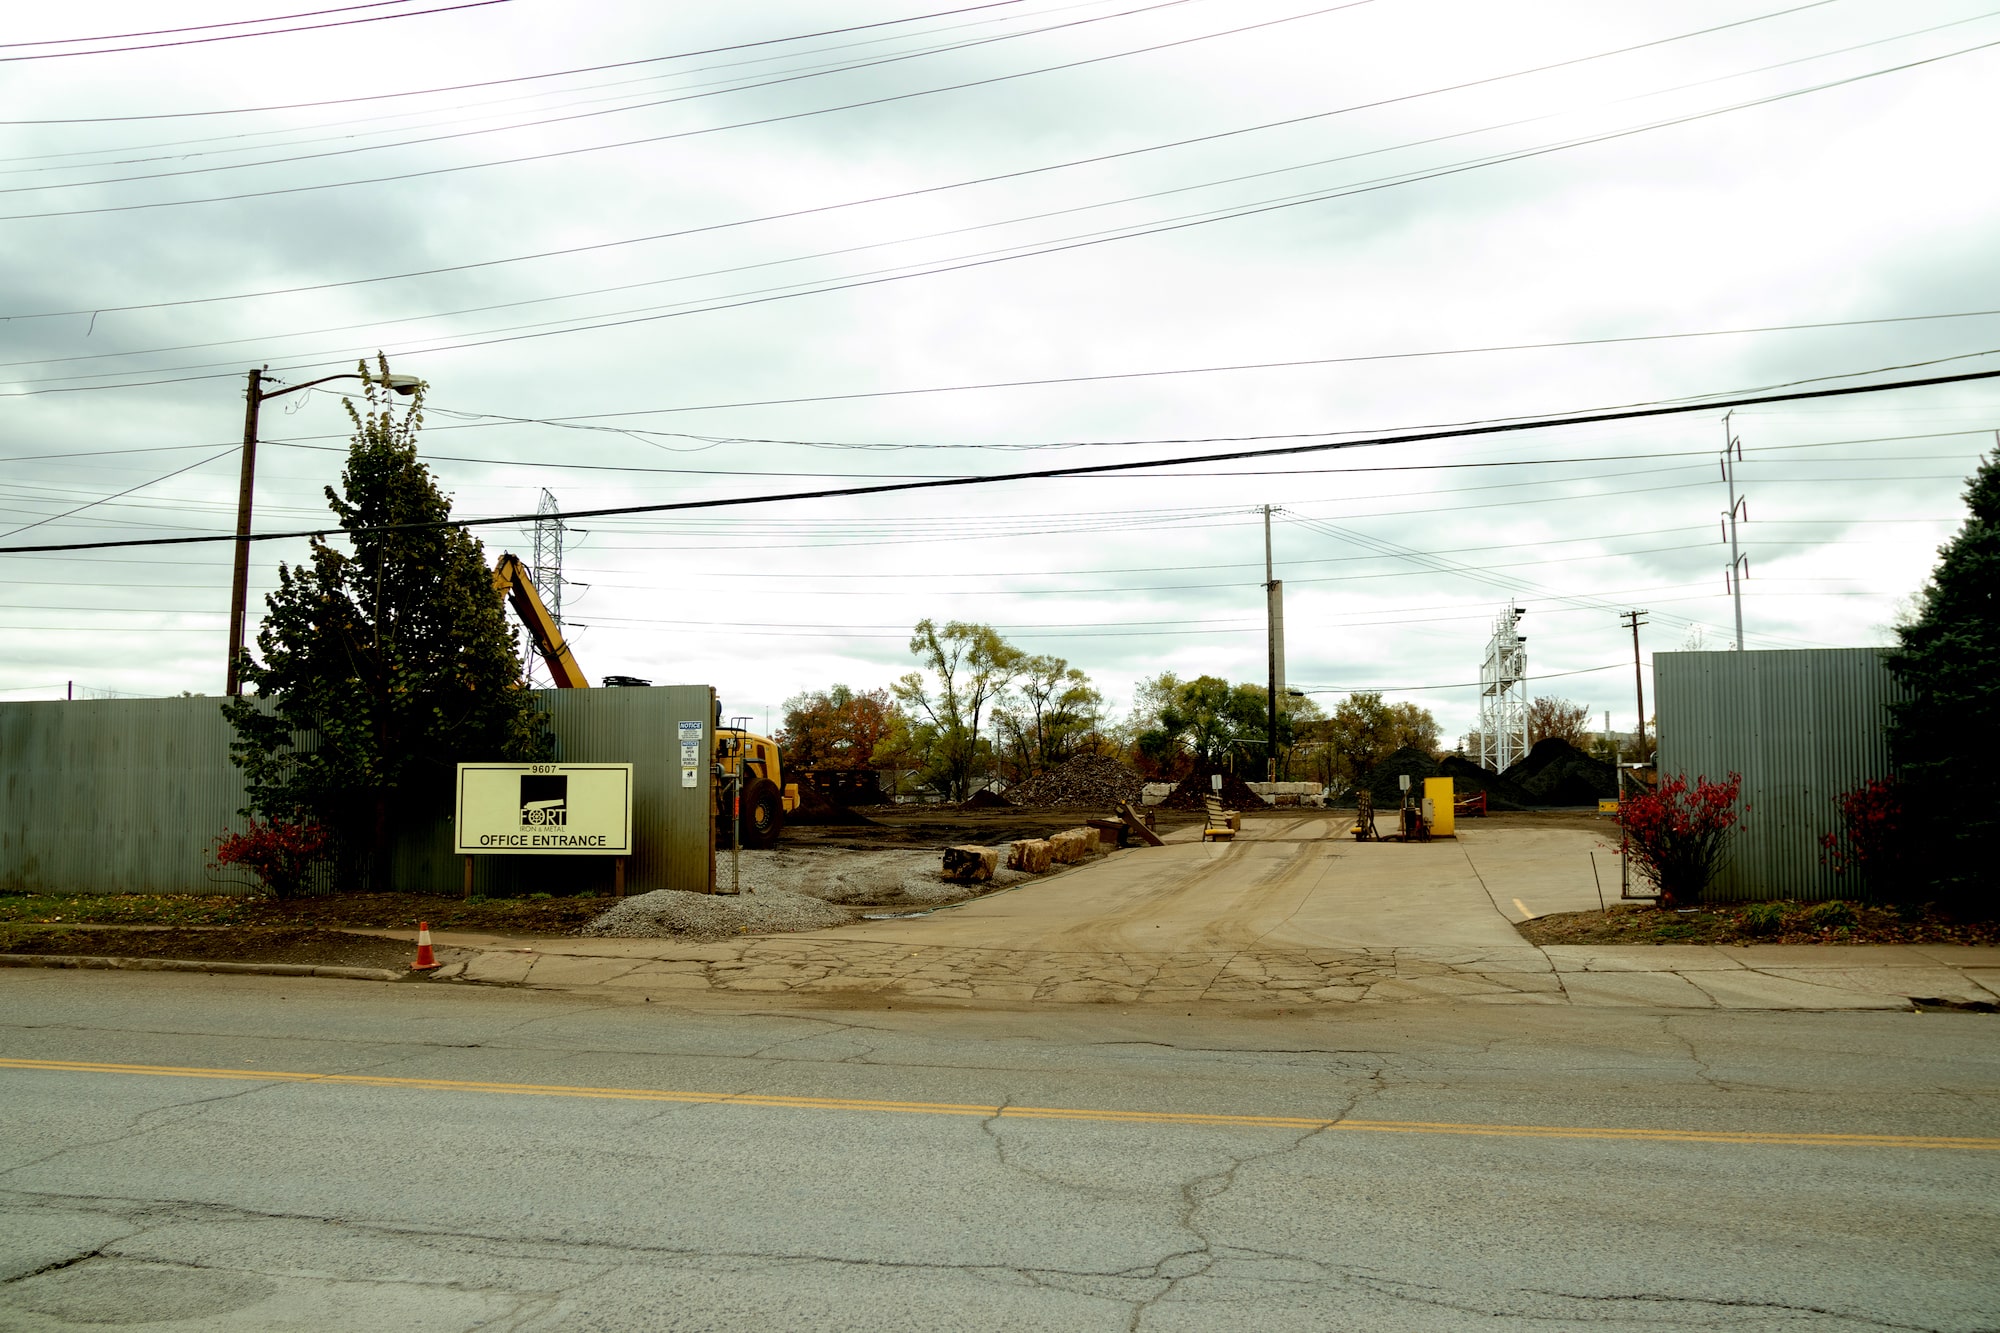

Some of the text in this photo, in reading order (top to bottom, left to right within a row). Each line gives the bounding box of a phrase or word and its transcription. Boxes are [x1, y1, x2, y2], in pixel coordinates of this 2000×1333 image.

[532, 765, 557, 774] 9607
[520, 808, 567, 825] FORT
[480, 835, 606, 846] OFFICE ENTRANCE
